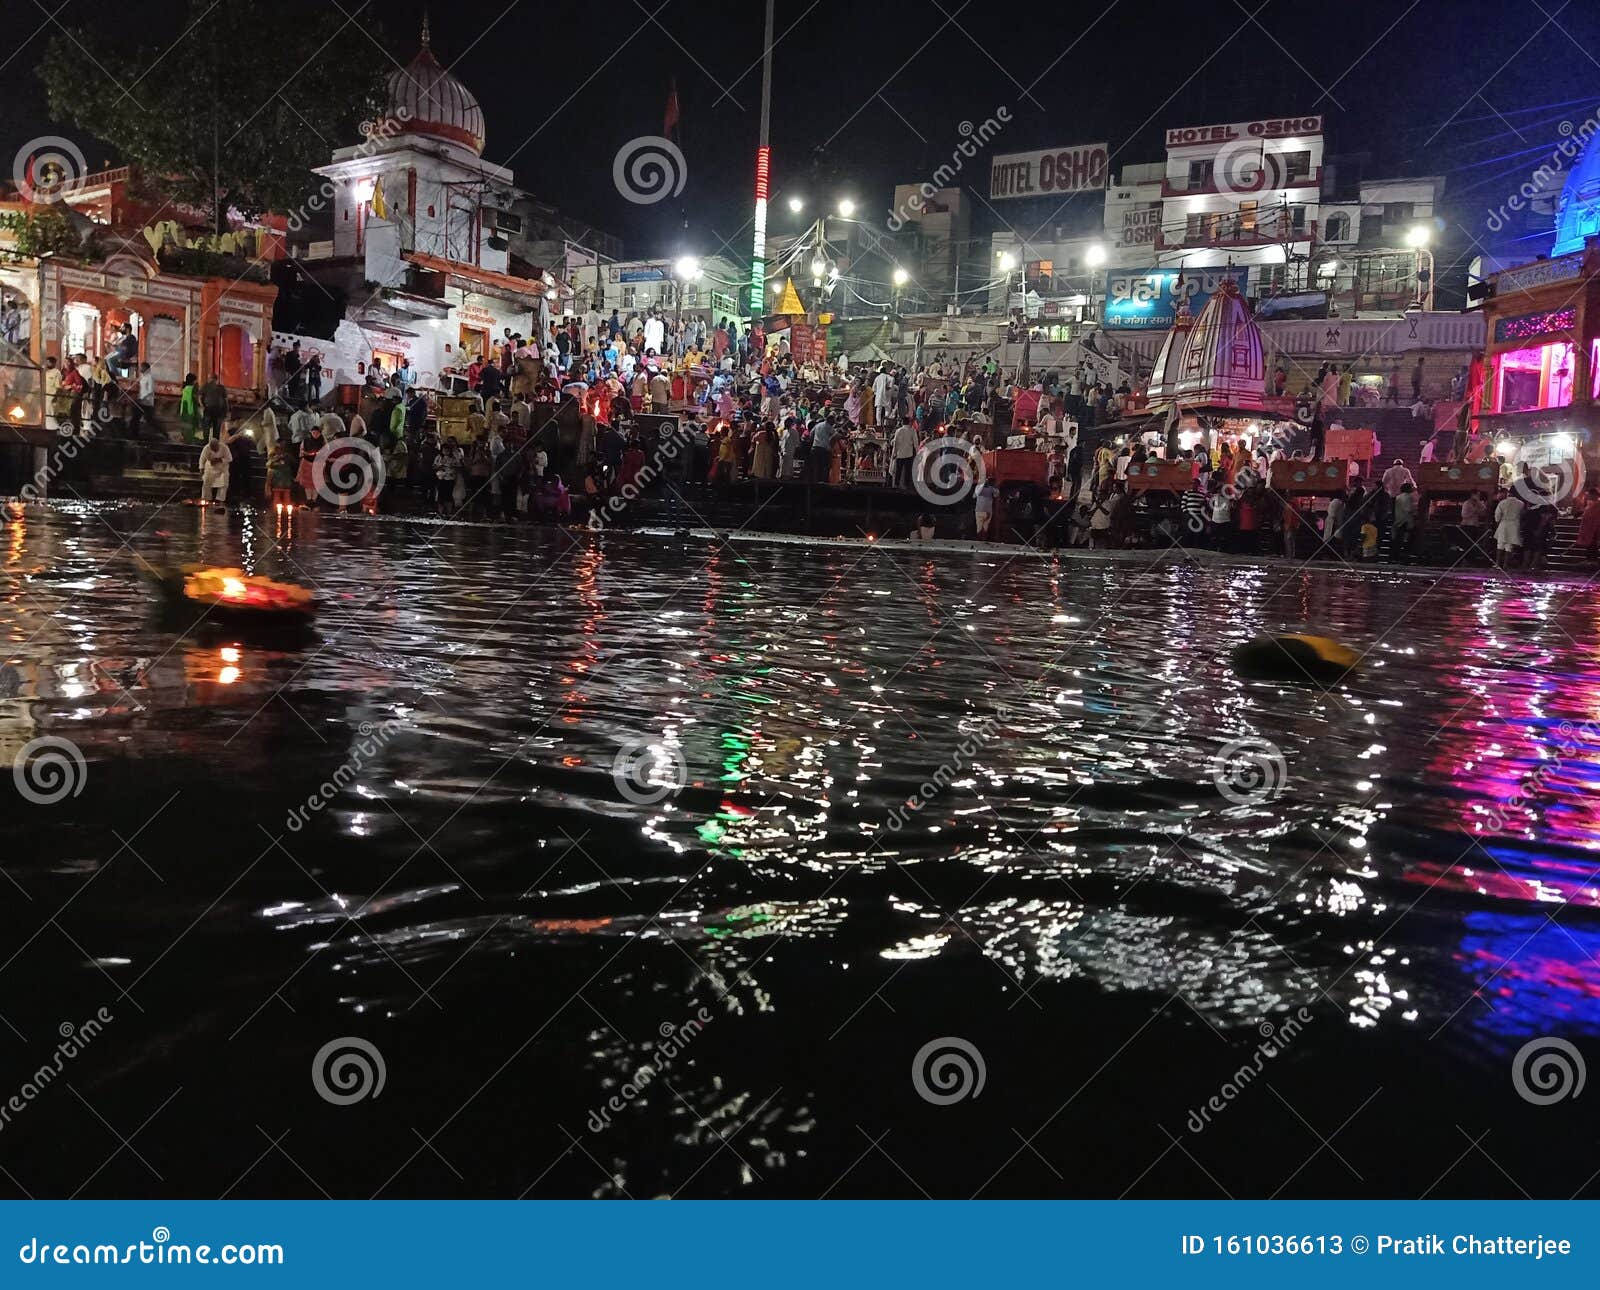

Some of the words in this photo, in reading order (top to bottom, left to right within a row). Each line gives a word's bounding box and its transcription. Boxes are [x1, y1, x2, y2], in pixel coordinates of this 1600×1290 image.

[1169, 125, 1239, 144] HOTEL
[1247, 117, 1320, 136] OSHO
[992, 161, 1034, 196] HOTEL
[1039, 149, 1106, 192] OSHO
[1124, 225, 1156, 244] OSH
[1111, 272, 1165, 307] ब्रह्म
[1124, 315, 1147, 325] गंगा
